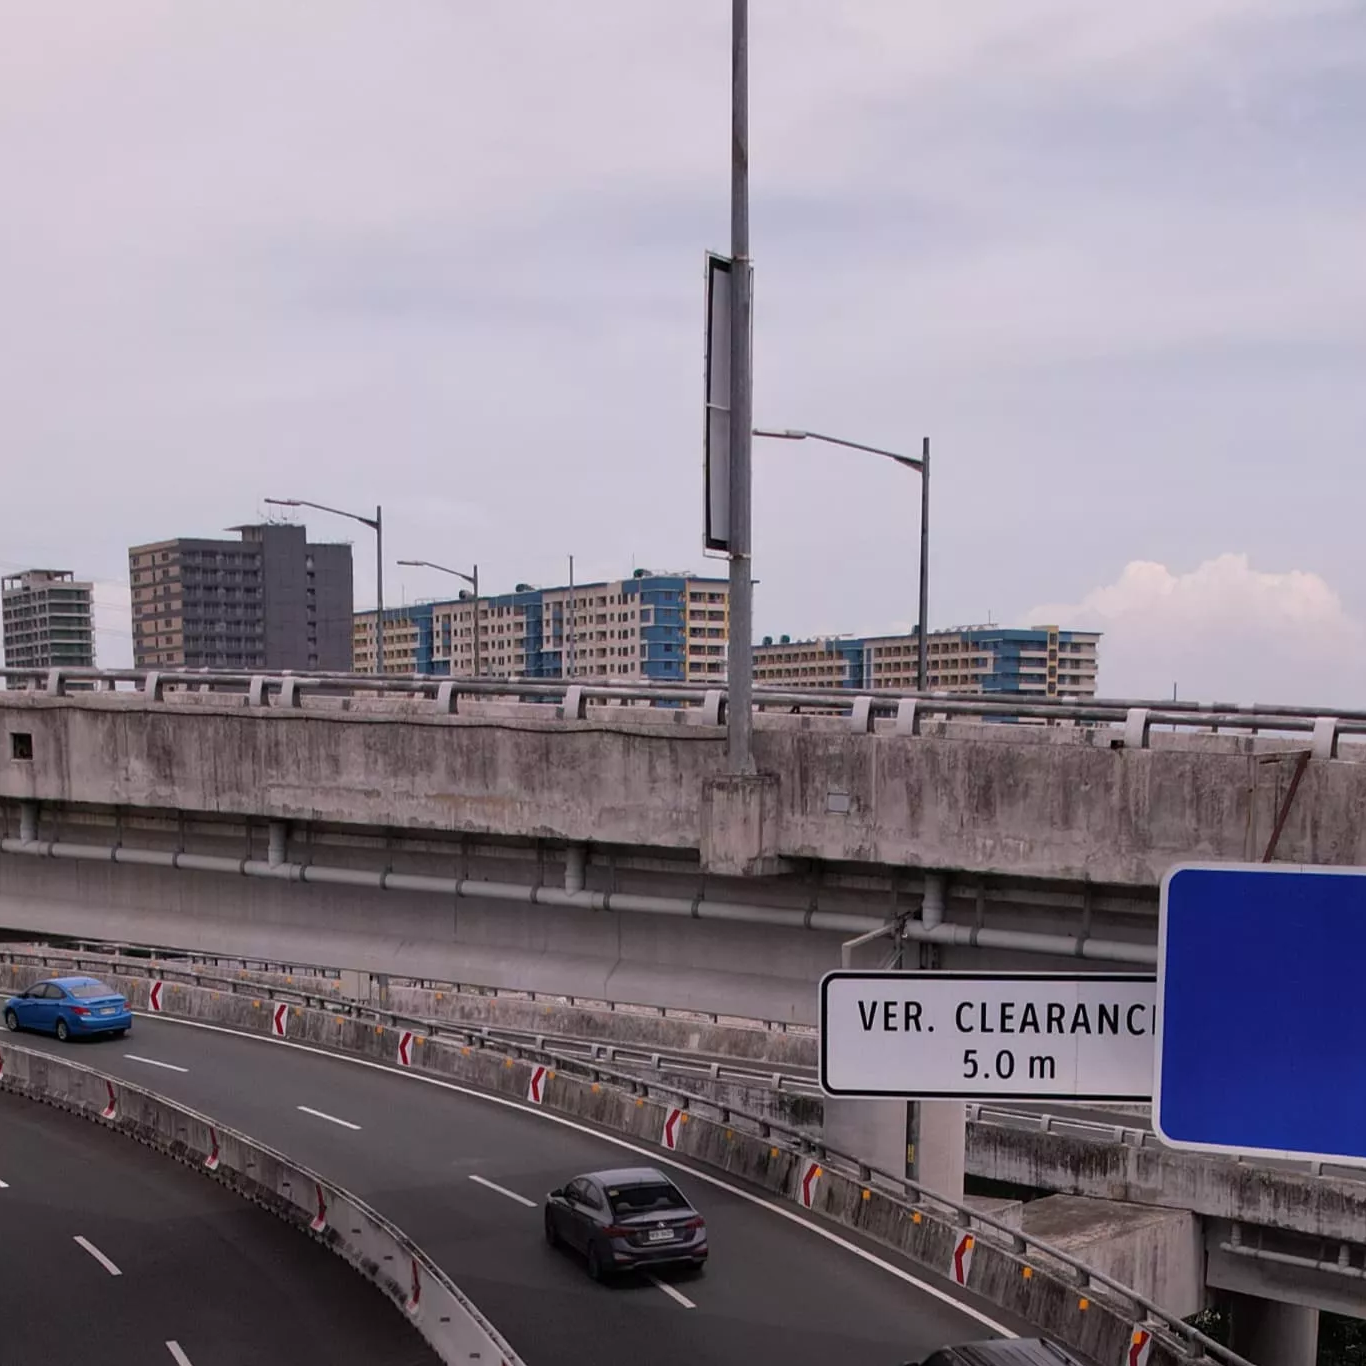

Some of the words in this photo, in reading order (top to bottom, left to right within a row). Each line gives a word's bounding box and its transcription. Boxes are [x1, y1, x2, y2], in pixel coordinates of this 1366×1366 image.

[857, 999, 936, 1034] VER.
[954, 1001, 1157, 1037] CLEARANC
[963, 1049, 1015, 1080] 5.0
[1028, 1055, 1056, 1080] m
